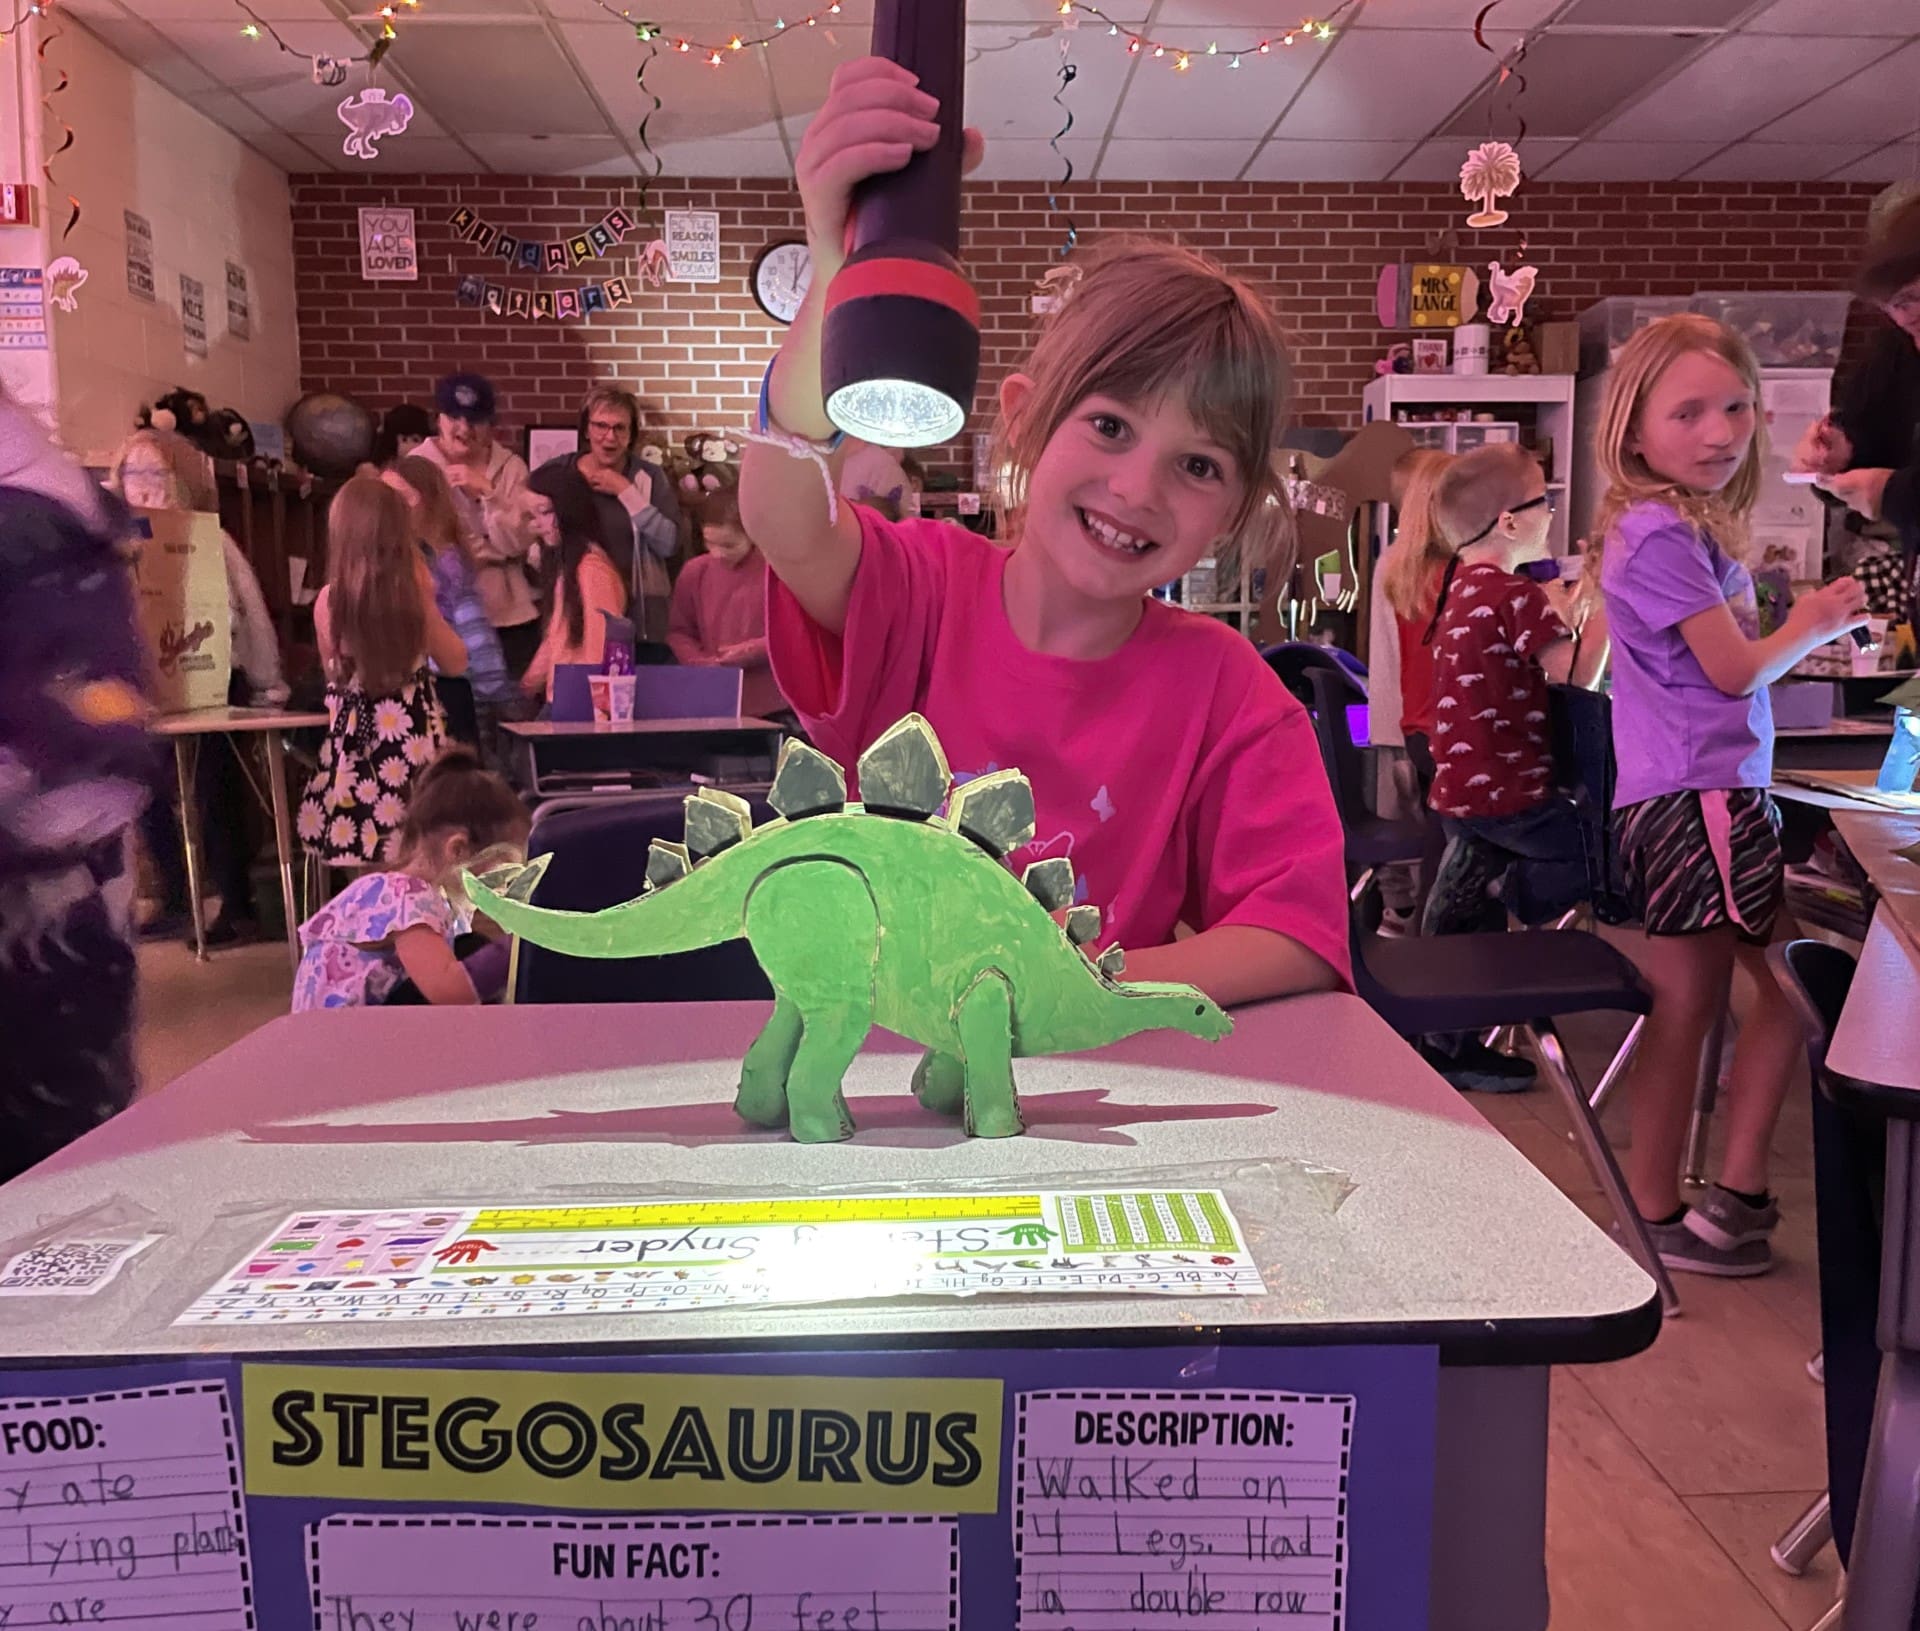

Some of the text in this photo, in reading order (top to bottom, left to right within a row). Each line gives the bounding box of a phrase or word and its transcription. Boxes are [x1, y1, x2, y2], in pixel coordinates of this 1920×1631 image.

[366, 217, 409, 233] YOU
[671, 219, 712, 231] BE THE
[672, 231, 714, 242] REASON
[366, 234, 414, 254] ARE
[367, 256, 413, 270] LOVED
[670, 250, 715, 262] SMILES
[672, 263, 714, 274] TODAY
[1420, 277, 1453, 293] MRS.
[1412, 295, 1458, 312] LANGE
[577, 1227, 761, 1261] Snyder
[941, 1278, 965, 1287] Hh
[980, 1273, 1004, 1286] Gg
[1020, 1276, 1042, 1286] Ff
[1059, 1274, 1082, 1284] Ee
[1098, 1273, 1121, 1284] Dd
[1137, 1272, 1160, 1283] Cc
[1175, 1271, 1201, 1282] Bb
[1214, 1271, 1239, 1281] Aa
[503, 1290, 525, 1300] Ss
[542, 1289, 569, 1300] Rr
[581, 1284, 608, 1299] Qq
[623, 1282, 648, 1297] Pp
[664, 1285, 687, 1295] Oo
[702, 1284, 729, 1294] Nn
[419, 1293, 445, 1303] Uu
[2, 1416, 106, 1454] FOOD:
[1074, 1411, 1294, 1448] DESCRIPTION:
[271, 1390, 982, 1488] STEGOSAURUS
[62, 1462, 135, 1507] ate
[1242, 1475, 1287, 1508] on
[1031, 1507, 1313, 1571] 4 Legs. Had
[553, 1542, 720, 1579] FUN FACT:
[1130, 1570, 1226, 1618] double
[1254, 1591, 1308, 1615] row
[49, 1596, 107, 1626] are
[324, 1590, 890, 1631] They were about 30 feet
